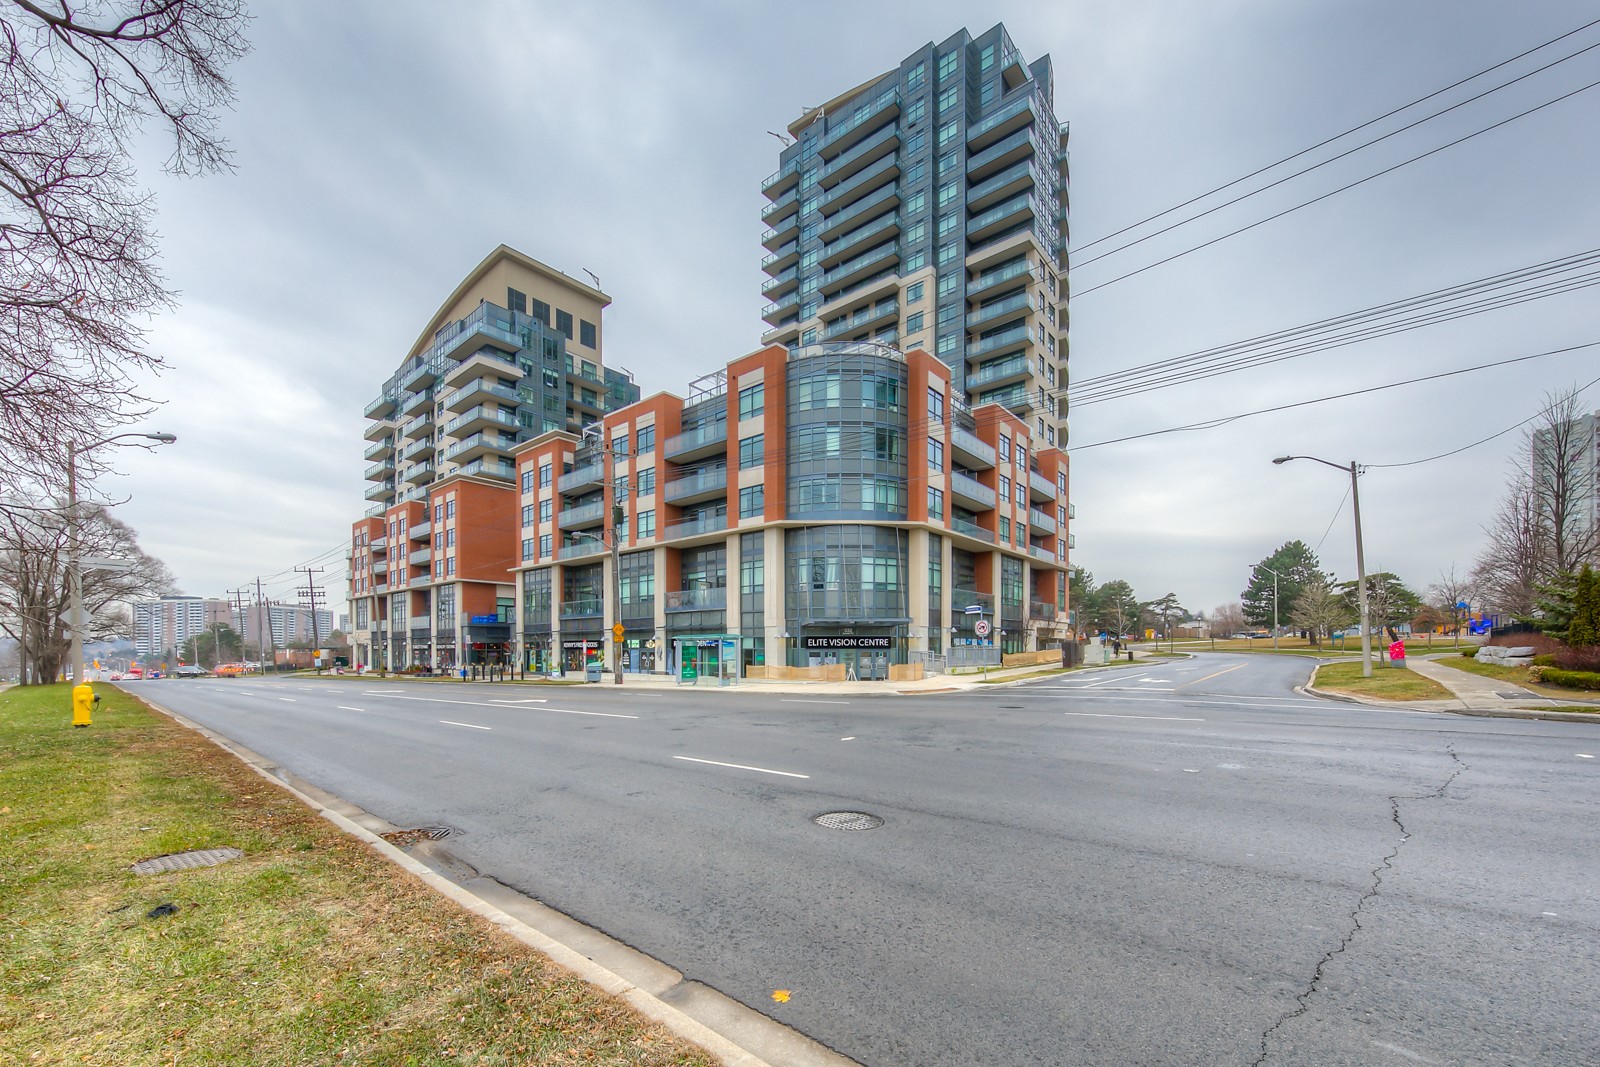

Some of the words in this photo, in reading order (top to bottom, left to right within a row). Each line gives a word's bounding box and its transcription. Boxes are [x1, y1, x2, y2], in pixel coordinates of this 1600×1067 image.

[807, 638, 828, 646] ELITE
[829, 638, 857, 646] VISION
[858, 638, 889, 646] CENTRE
